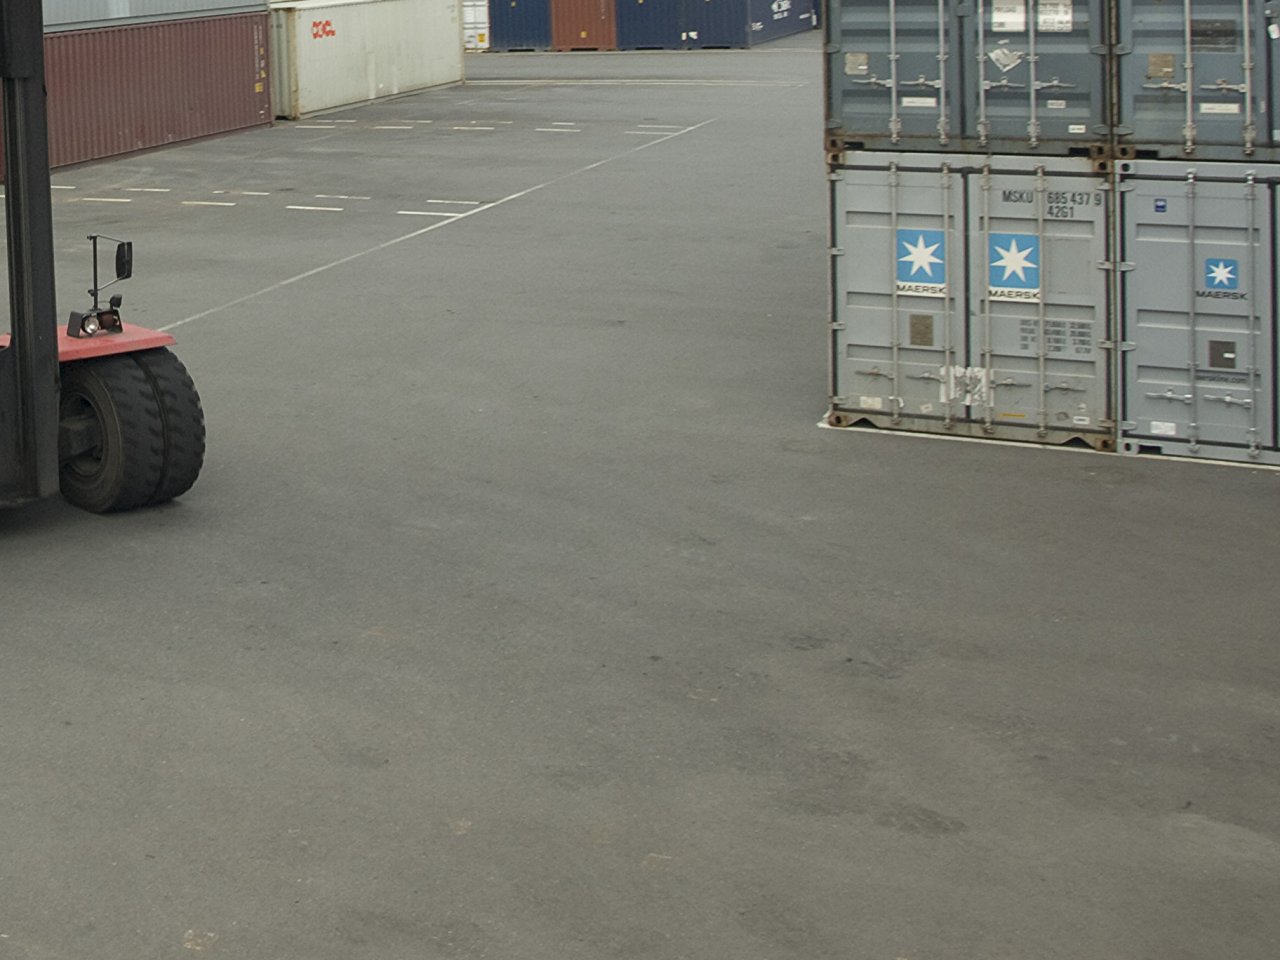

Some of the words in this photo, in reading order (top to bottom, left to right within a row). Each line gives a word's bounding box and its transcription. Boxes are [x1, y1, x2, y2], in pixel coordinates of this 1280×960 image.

[1003, 190, 1033, 203] MSKU
[1070, 192, 1091, 205] 437
[896, 283, 947, 295] MAERSK
[989, 289, 1041, 300] MAERSK
[1196, 290, 1249, 301] MAERSK
